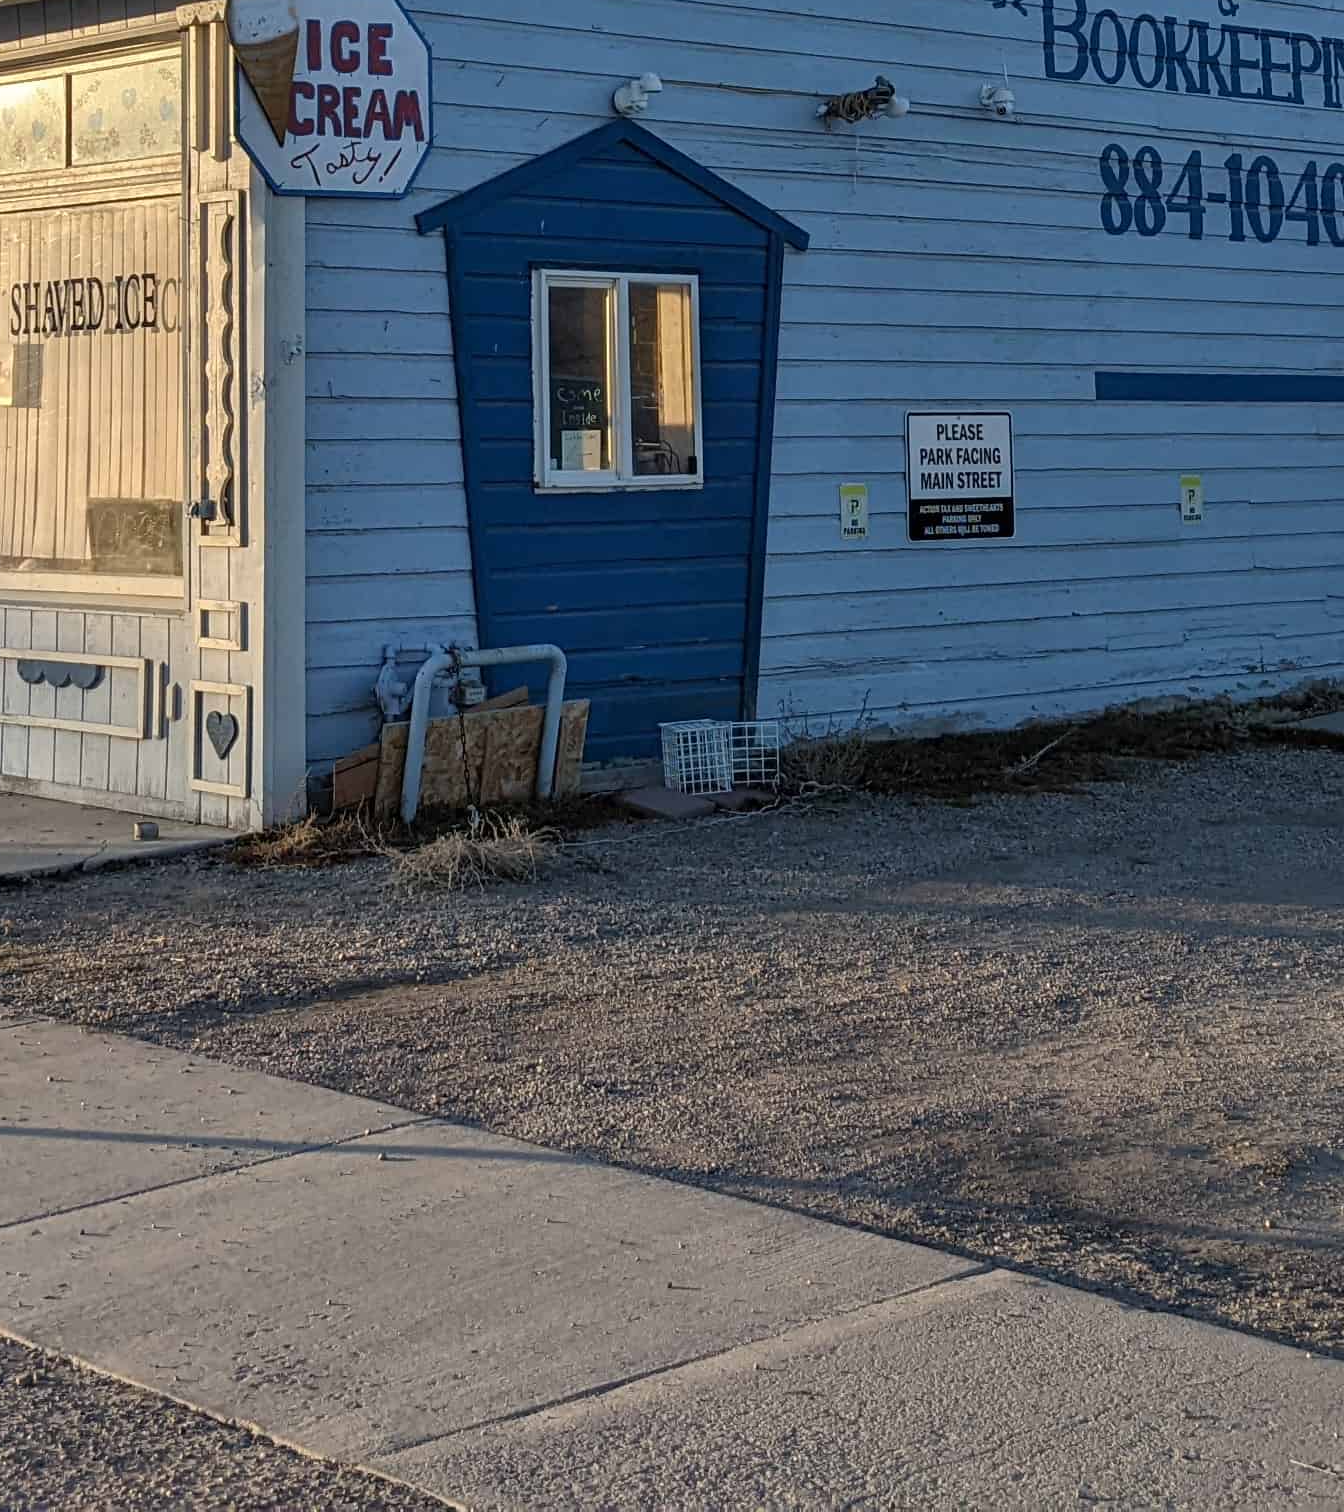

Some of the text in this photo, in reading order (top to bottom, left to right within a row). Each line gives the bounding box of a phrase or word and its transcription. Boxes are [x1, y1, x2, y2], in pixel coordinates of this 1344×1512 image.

[306, 19, 394, 76] ICE
[287, 81, 425, 143] CREAM
[290, 141, 402, 186] Tasty!
[10, 273, 157, 336] SHAVED ICE
[557, 387, 602, 403] Come
[936, 423, 985, 441] PLEASE
[919, 447, 1001, 466] PARK FACING
[920, 471, 1002, 490] MAIN STREET
